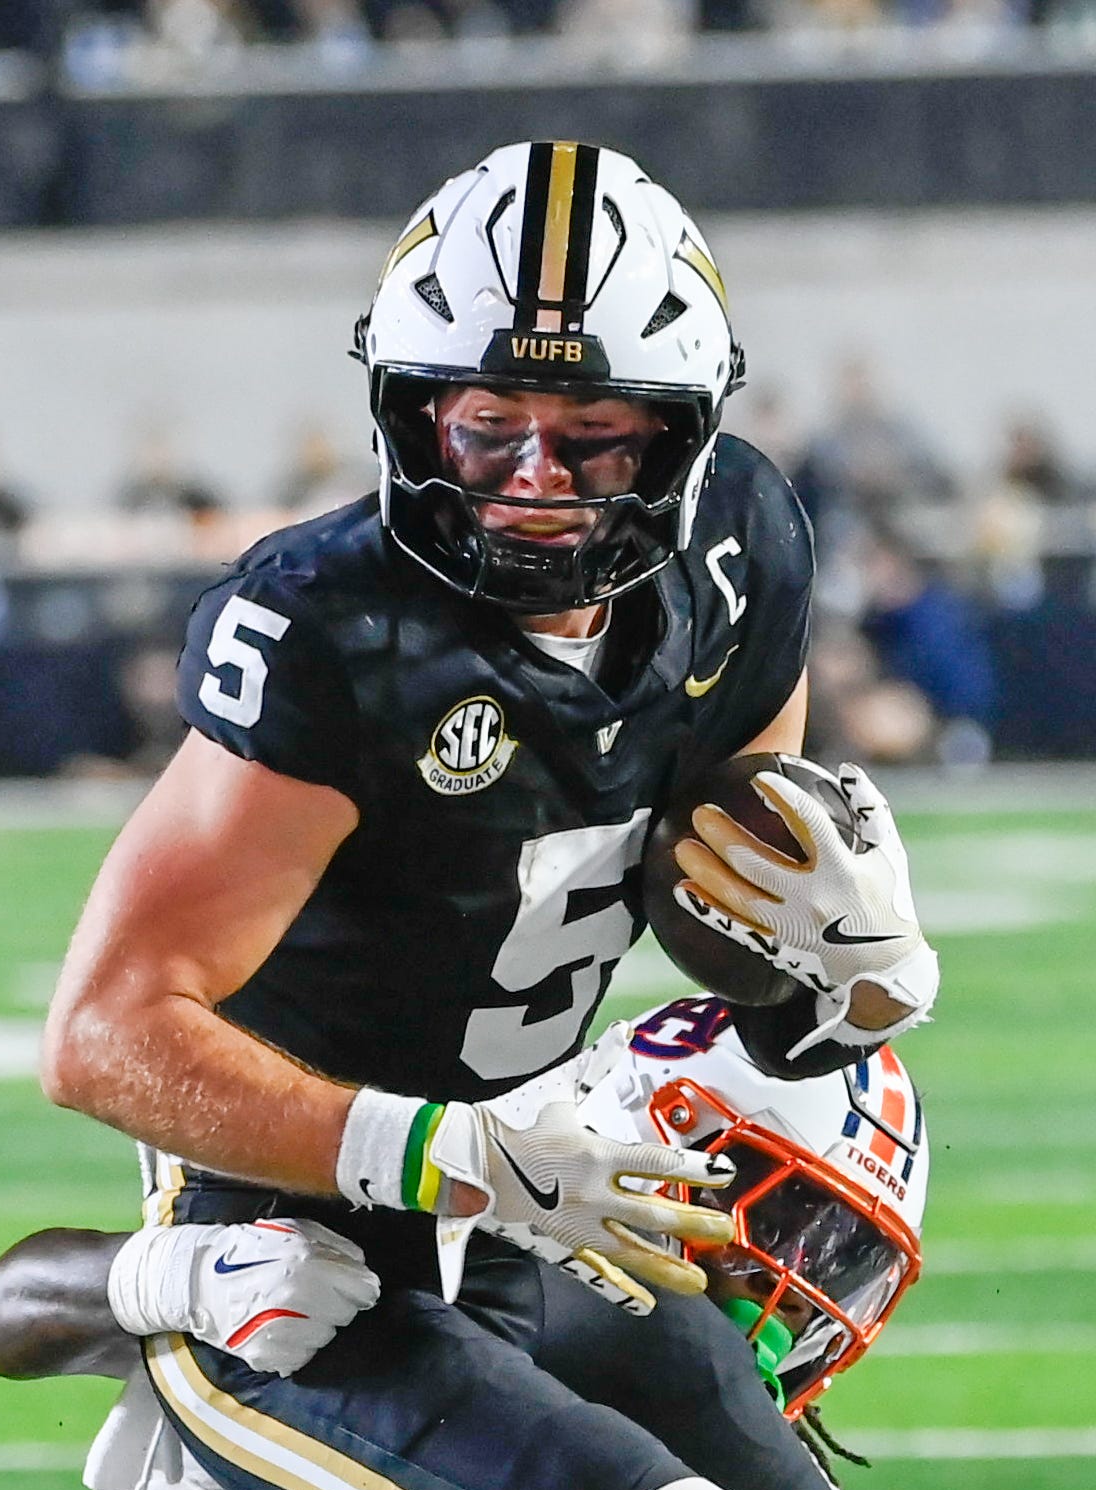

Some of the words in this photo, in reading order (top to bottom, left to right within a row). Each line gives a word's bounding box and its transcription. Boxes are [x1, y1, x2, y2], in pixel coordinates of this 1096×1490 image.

[511, 337, 582, 362] VUFB
[705, 536, 747, 626] C
[198, 594, 292, 729] 5
[438, 702, 501, 770] SEC
[428, 758, 504, 792] GRADUATE
[459, 806, 652, 1081] 5
[847, 1145, 907, 1202] TIGERS
